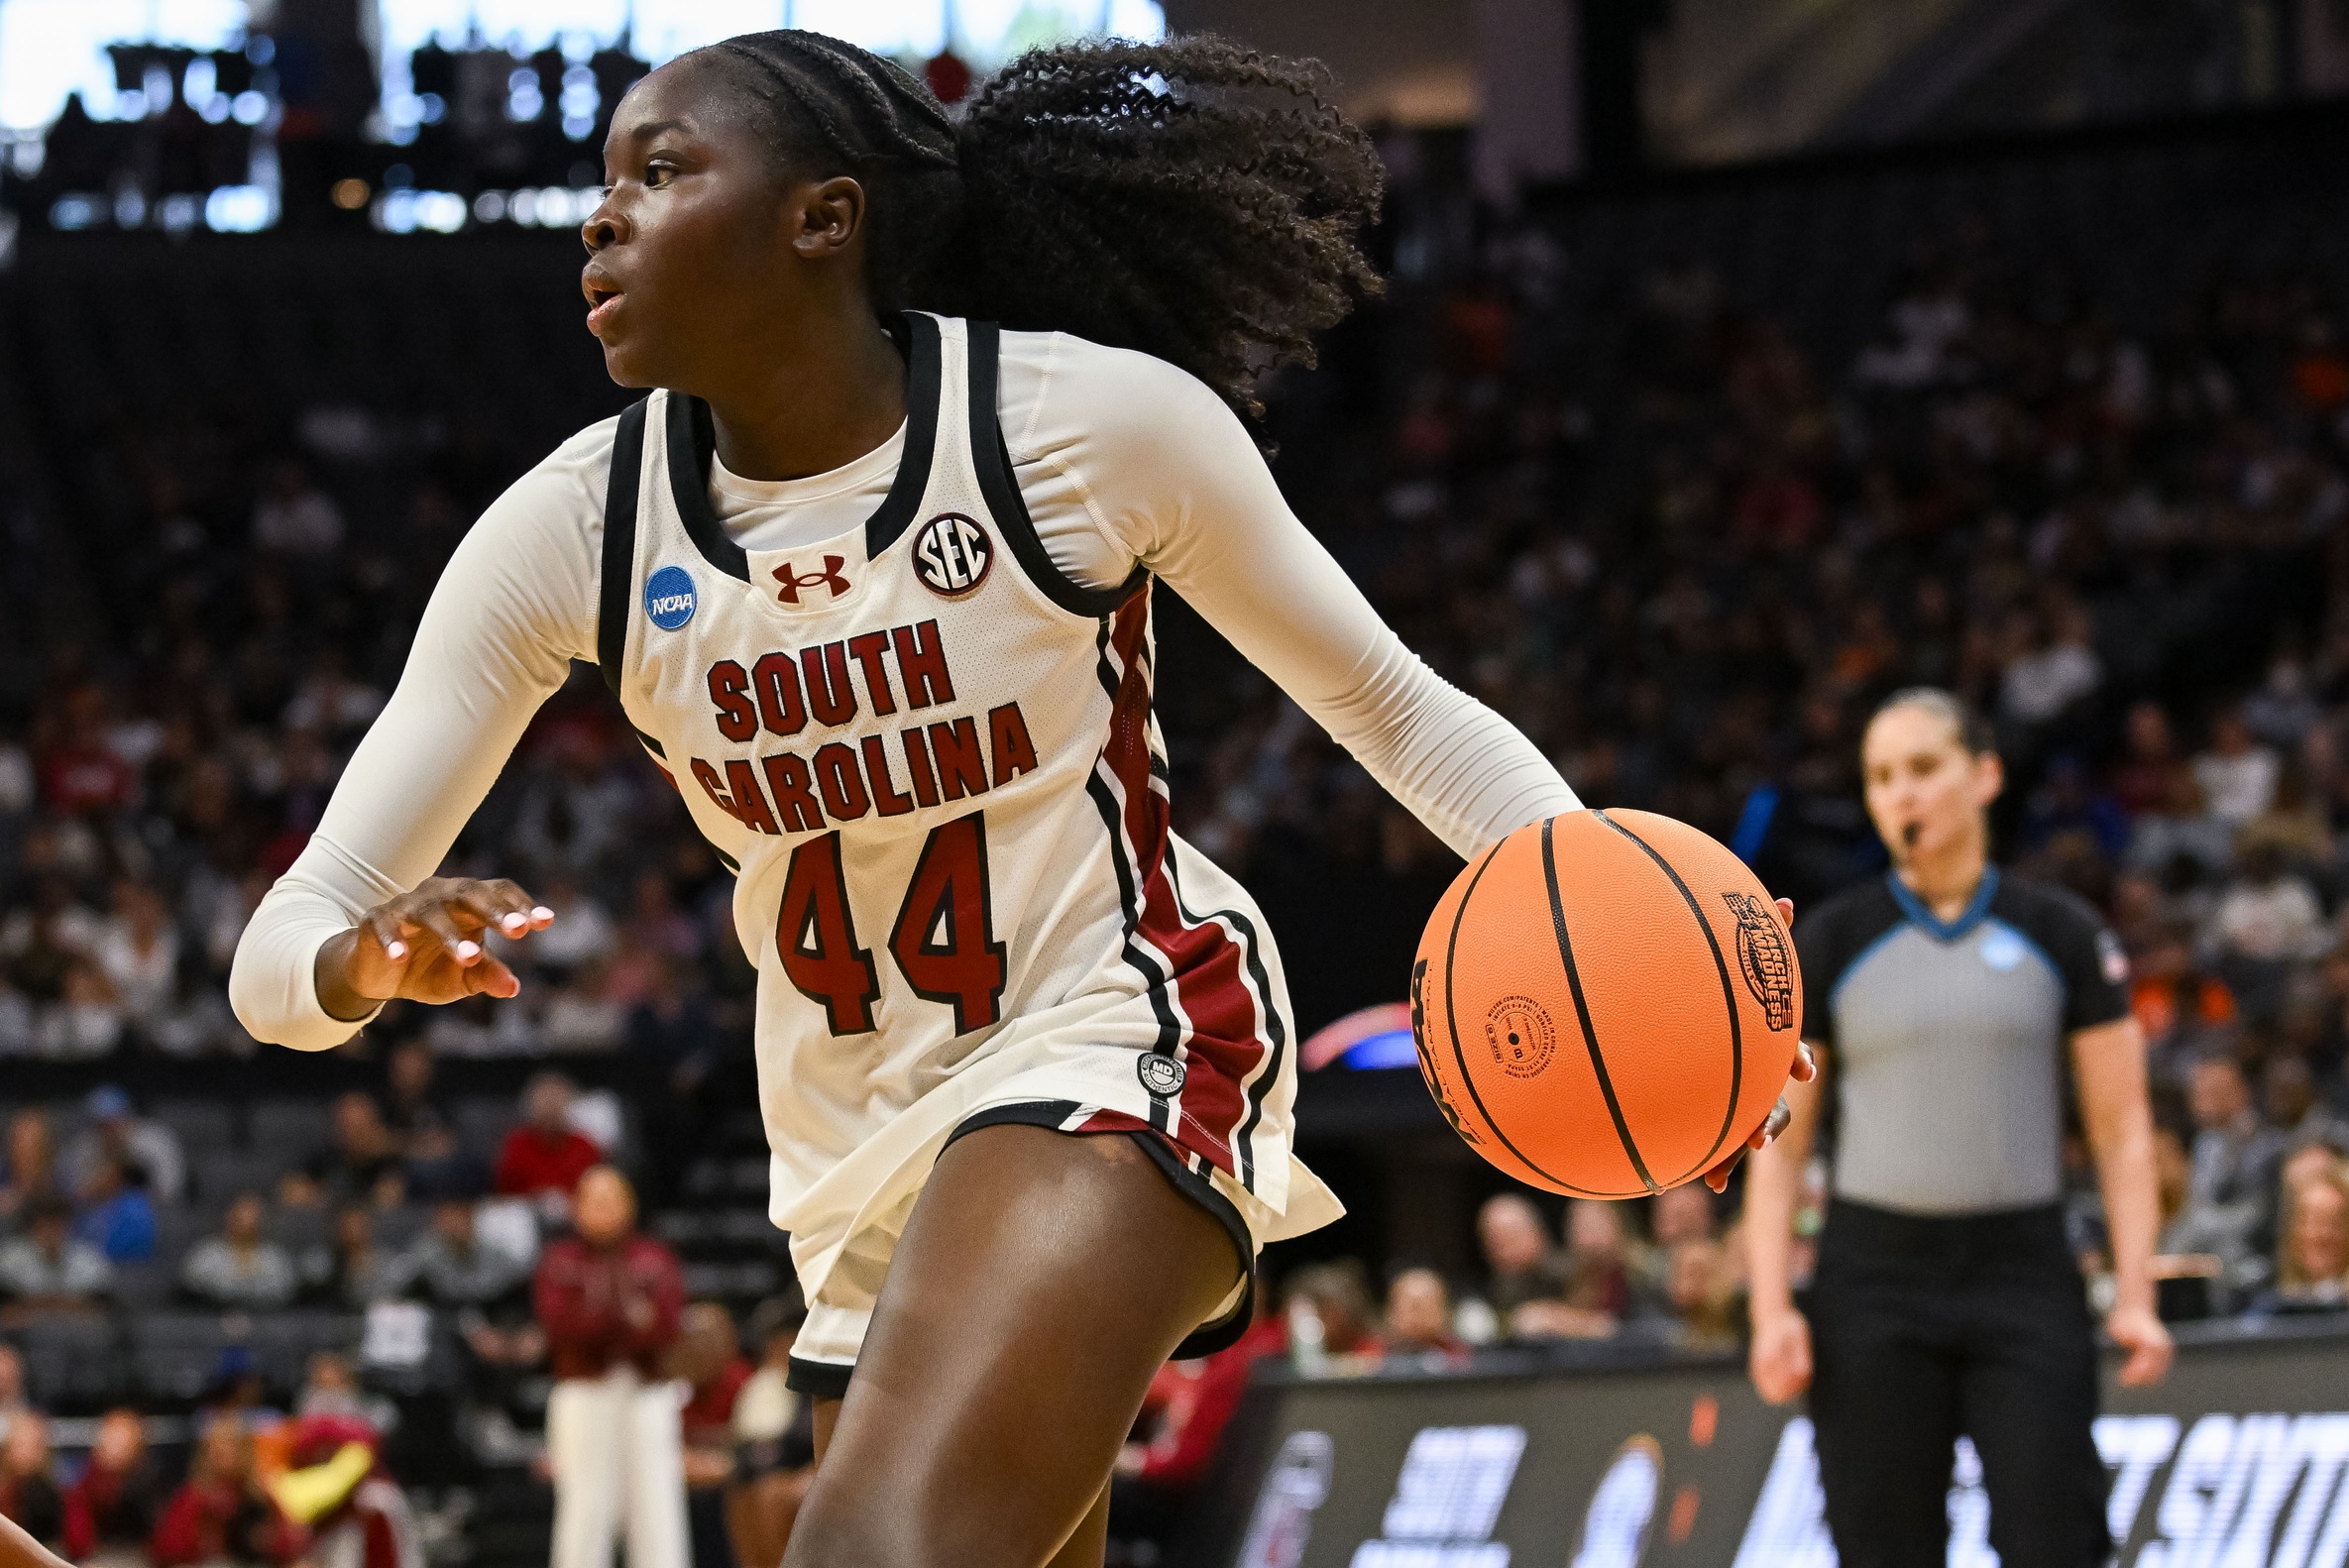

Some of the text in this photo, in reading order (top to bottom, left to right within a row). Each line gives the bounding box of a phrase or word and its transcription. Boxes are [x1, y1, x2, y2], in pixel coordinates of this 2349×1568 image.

[918, 516, 986, 589] SEC
[651, 591, 693, 616] NCAA
[707, 618, 956, 743] SOUTH
[690, 701, 1039, 836] CAROLINA
[776, 811, 1007, 1038] 44
[1757, 917, 1789, 990] MARCH
[1749, 929, 1783, 1031] MADNESS
[1144, 1073, 1178, 1093] AUTHENTIC
[1152, 1061, 1174, 1076] MD
